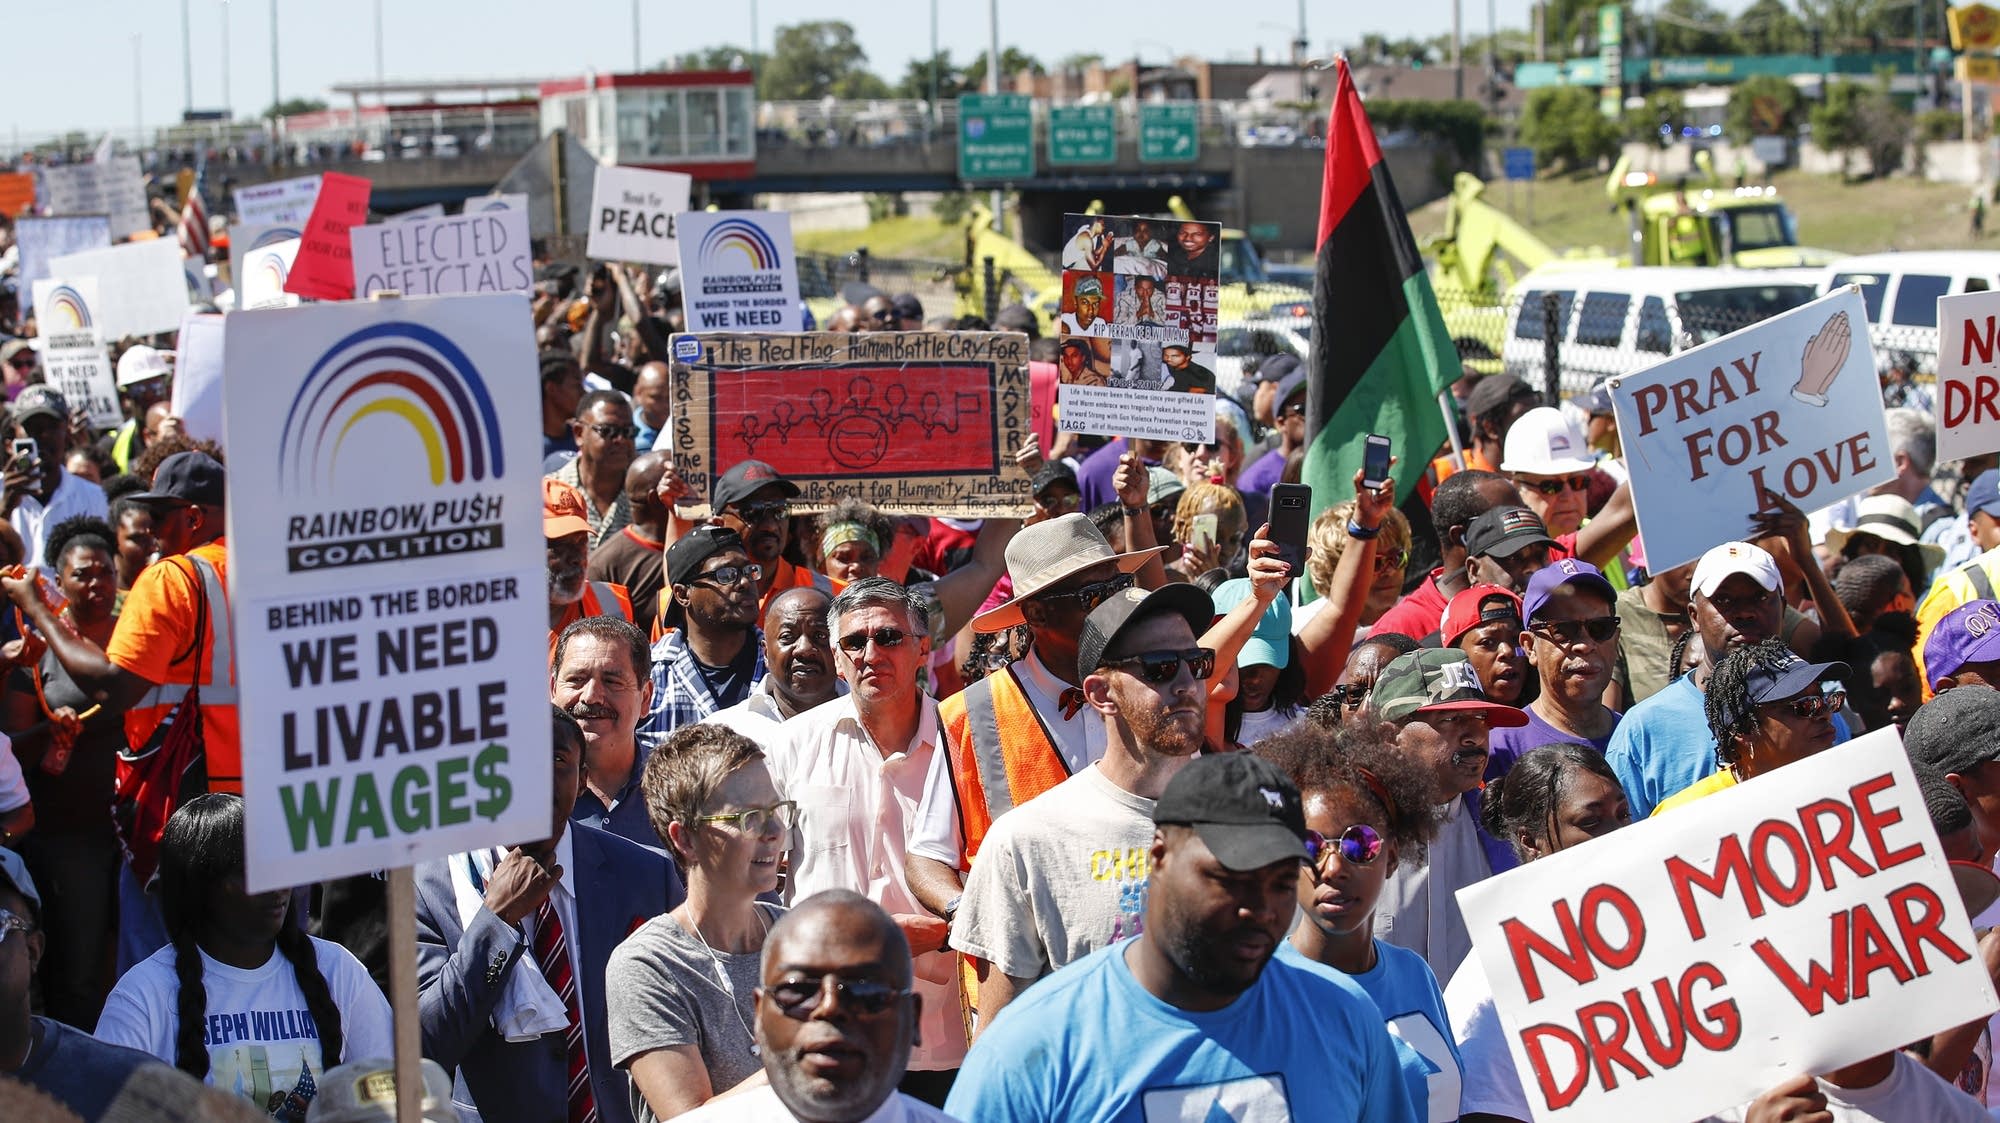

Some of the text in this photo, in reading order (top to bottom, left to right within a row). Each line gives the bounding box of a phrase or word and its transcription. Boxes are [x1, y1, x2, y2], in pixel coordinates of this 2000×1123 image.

[380, 217, 507, 268] ELECTED
[601, 208, 676, 239] PEACE
[695, 301, 729, 309] BEHIND
[753, 298, 787, 306] BORDER
[701, 310, 782, 327] WE NEED
[719, 338, 752, 362] The
[759, 336, 795, 362] Red
[1093, 324, 1106, 336] RIP
[1962, 315, 2000, 366] N
[1632, 352, 1762, 437] PRAY
[1683, 410, 1788, 482] FOR
[1748, 432, 1877, 514] LOVE
[298, 530, 492, 568] COALITION
[268, 577, 519, 631] BEHIND THE BORDER
[282, 617, 499, 689] WE NEED
[1441, 662, 1484, 694] JES
[282, 681, 508, 771] LIVABLE
[1091, 848, 1152, 881] CHI
[1499, 772, 1926, 1004] NO MORE
[1520, 883, 1971, 1112] DRUG WAR
